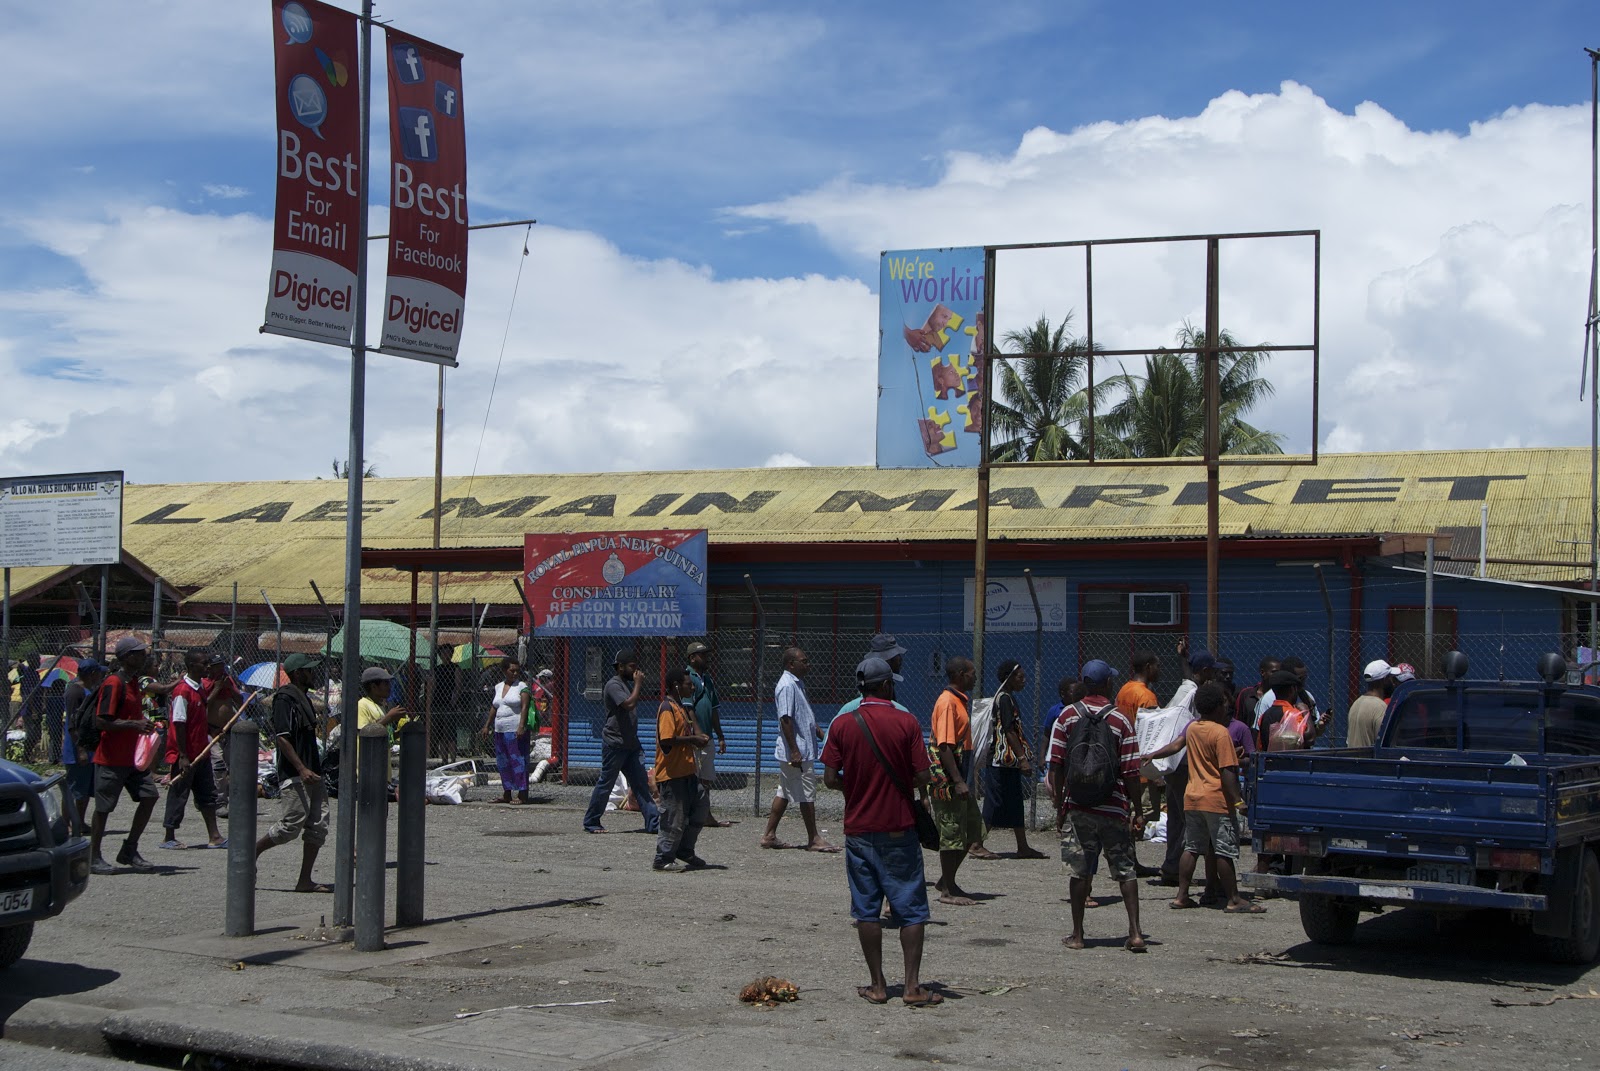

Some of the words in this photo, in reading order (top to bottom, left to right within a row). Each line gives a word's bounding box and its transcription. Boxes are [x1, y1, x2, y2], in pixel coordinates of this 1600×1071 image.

[280, 129, 358, 197] Best
[305, 191, 332, 217] For
[394, 162, 465, 225] Best
[287, 211, 347, 251] Email
[419, 224, 440, 245] For
[395, 241, 462, 274] Facebook
[889, 256, 935, 280] We're
[274, 270, 352, 312] Digicel
[271, 311, 288, 320] PNG's
[307, 318, 324, 327] Better
[388, 295, 460, 334] Digicel
[386, 334, 401, 342] PNG's
[419, 340, 434, 348] Better
[131, 499, 399, 525] LAE
[416, 490, 782, 520] MAIN
[815, 474, 1527, 513] MARKET
[526, 549, 572, 585] ROYAL
[572, 537, 617, 557] PAPUA
[619, 536, 655, 554] NEW
[654, 544, 706, 587] GUINEA
[552, 584, 679, 600] CONSTABULARY
[545, 613, 615, 629] MARKET
[619, 613, 682, 629] STATION
